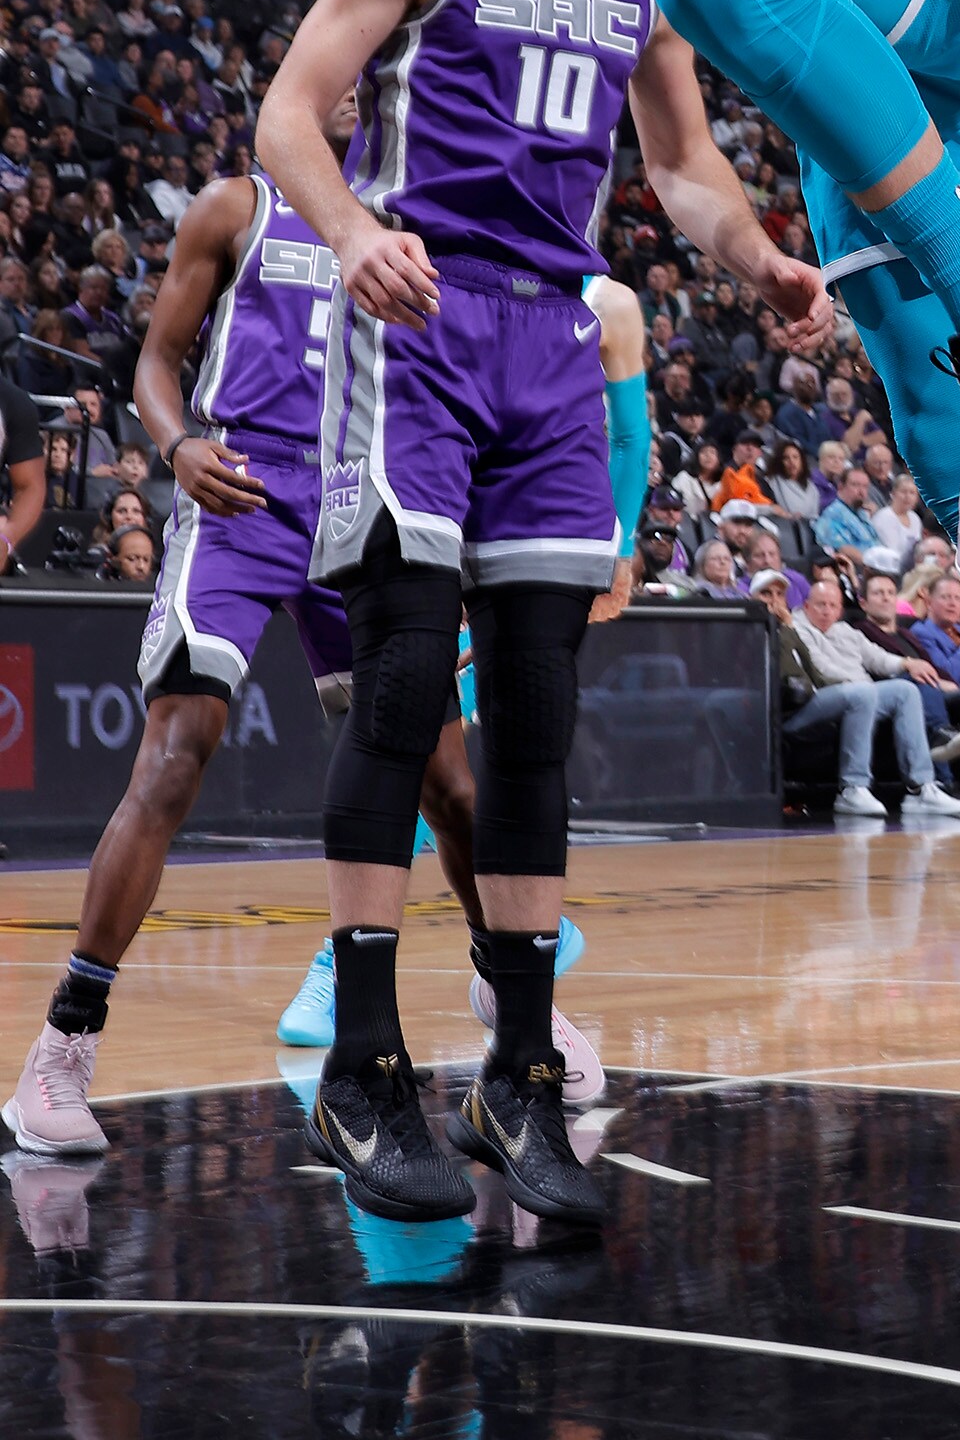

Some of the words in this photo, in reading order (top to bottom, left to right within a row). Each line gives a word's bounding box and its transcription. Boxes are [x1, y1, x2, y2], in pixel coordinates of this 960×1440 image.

[514, 42, 599, 135] 10
[259, 237, 340, 290] SA
[55, 681, 279, 750] TOA
